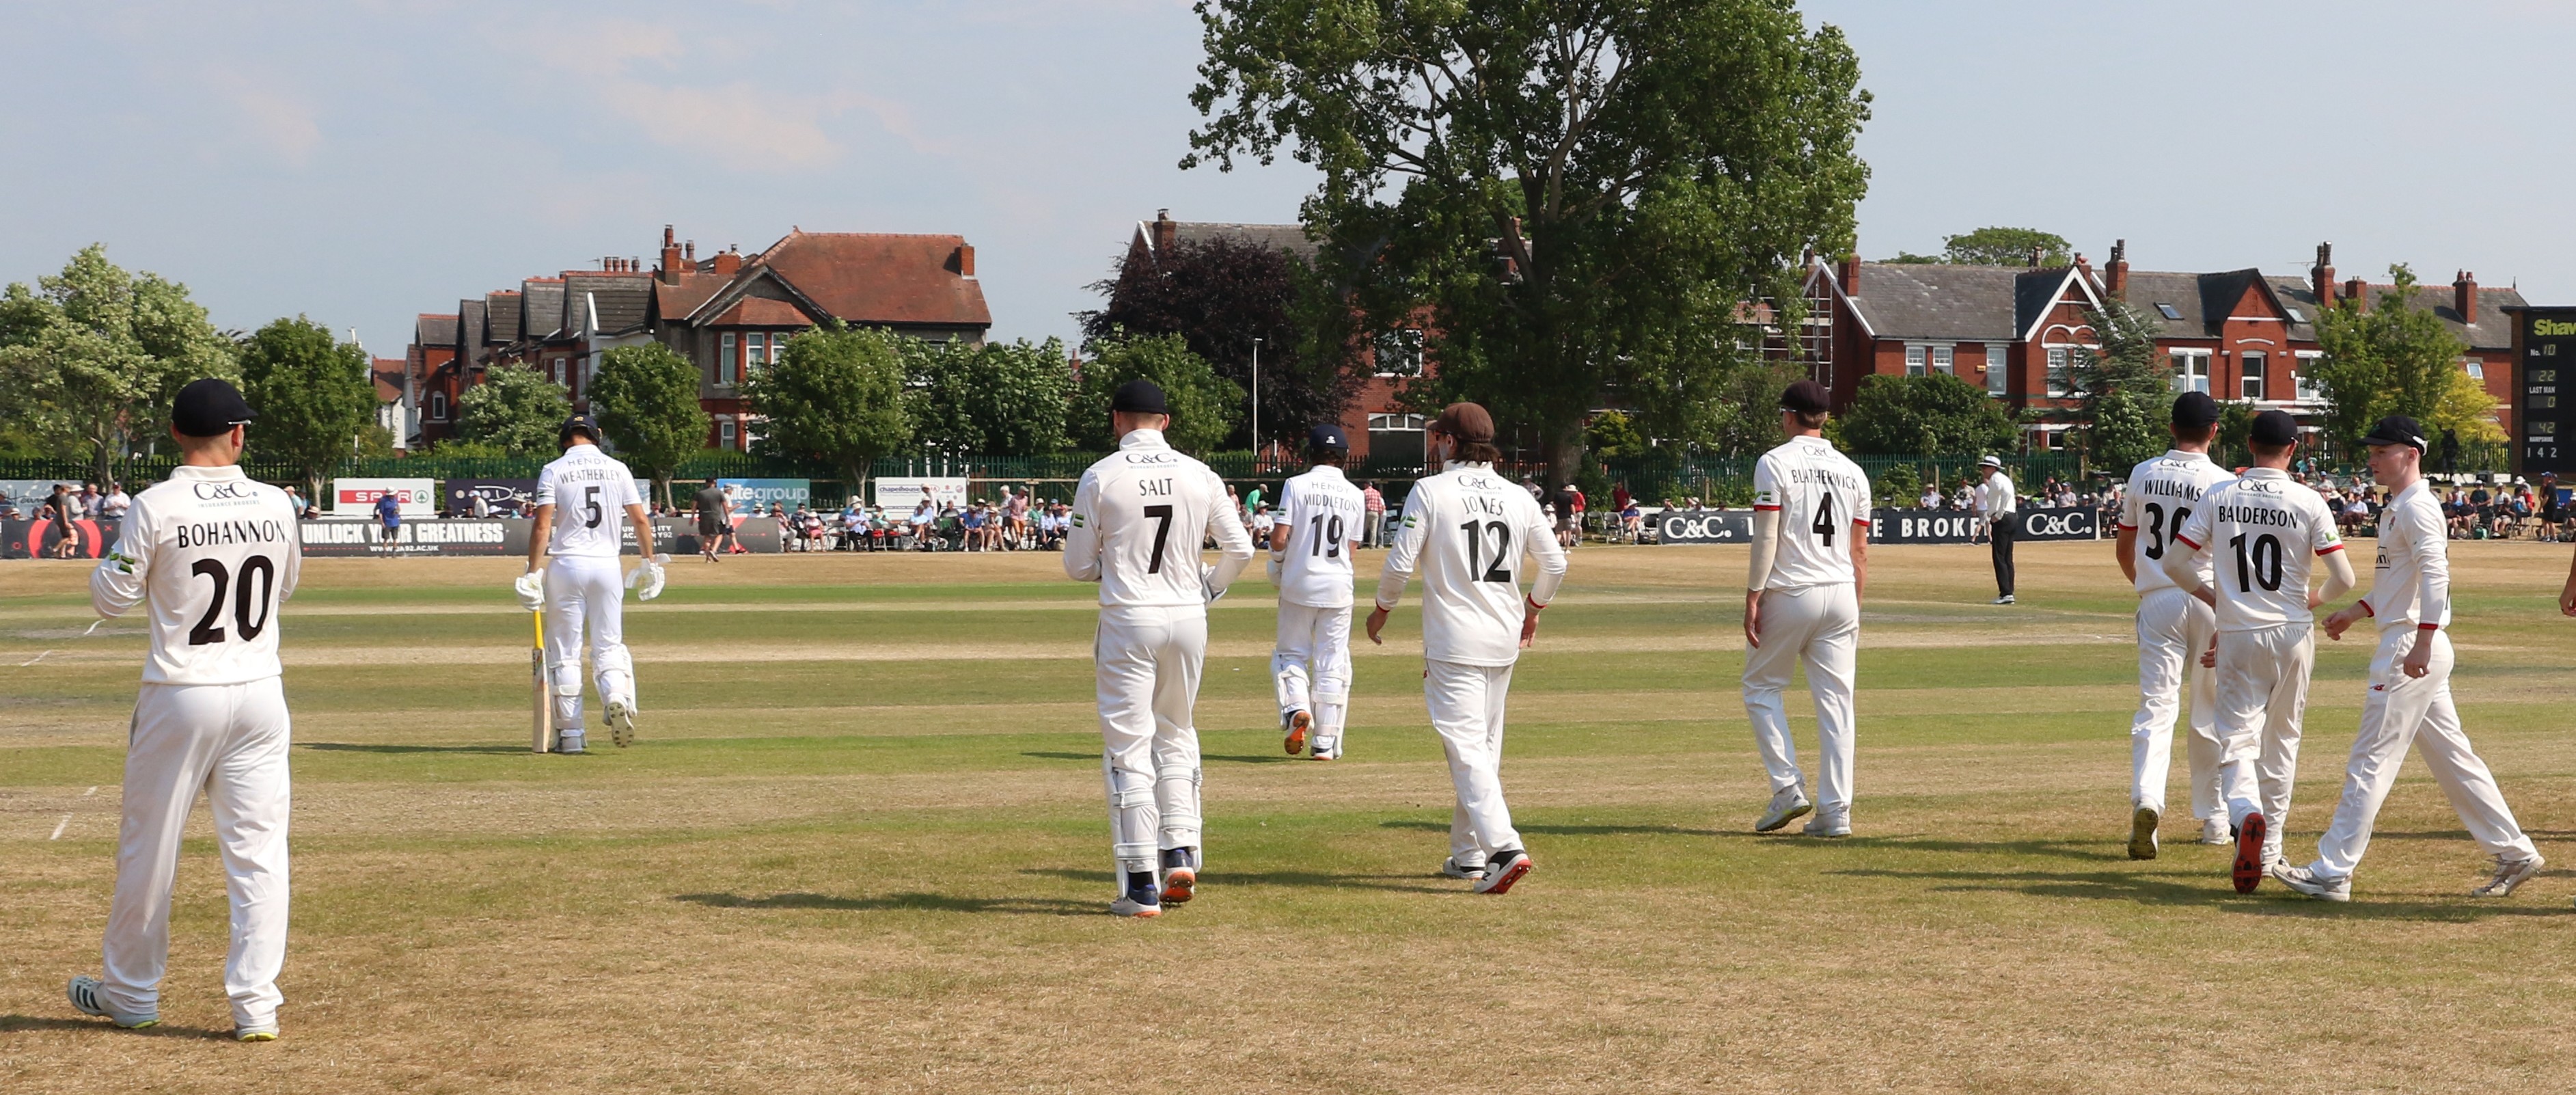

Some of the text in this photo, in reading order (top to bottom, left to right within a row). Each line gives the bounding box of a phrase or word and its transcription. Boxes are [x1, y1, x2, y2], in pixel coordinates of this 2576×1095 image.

[2538, 370, 2556, 381] 22
[2539, 422, 2554, 433] 42
[568, 458, 607, 466] HENDY
[560, 469, 620, 484] WEATHERLEY
[1139, 478, 1173, 496] SALT
[1312, 482, 1349, 493] HENDY
[356, 492, 410, 501] SPR
[2145, 479, 2202, 502] WILLIAMS
[585, 486, 602, 528] 5
[1304, 494, 1356, 512] MIDDLETON
[1462, 496, 1505, 516] JONES
[1812, 491, 1835, 547] 4
[2219, 506, 2298, 529] BALDERSON
[177, 520, 285, 548] BOHANNON
[301, 524, 365, 543] UNLOCK
[416, 522, 504, 543] GREATNESS
[1144, 505, 1173, 574] 7
[1311, 513, 1344, 558] 19
[1460, 519, 1510, 582] 12
[2229, 532, 2282, 593] 10
[188, 555, 274, 645] 20
